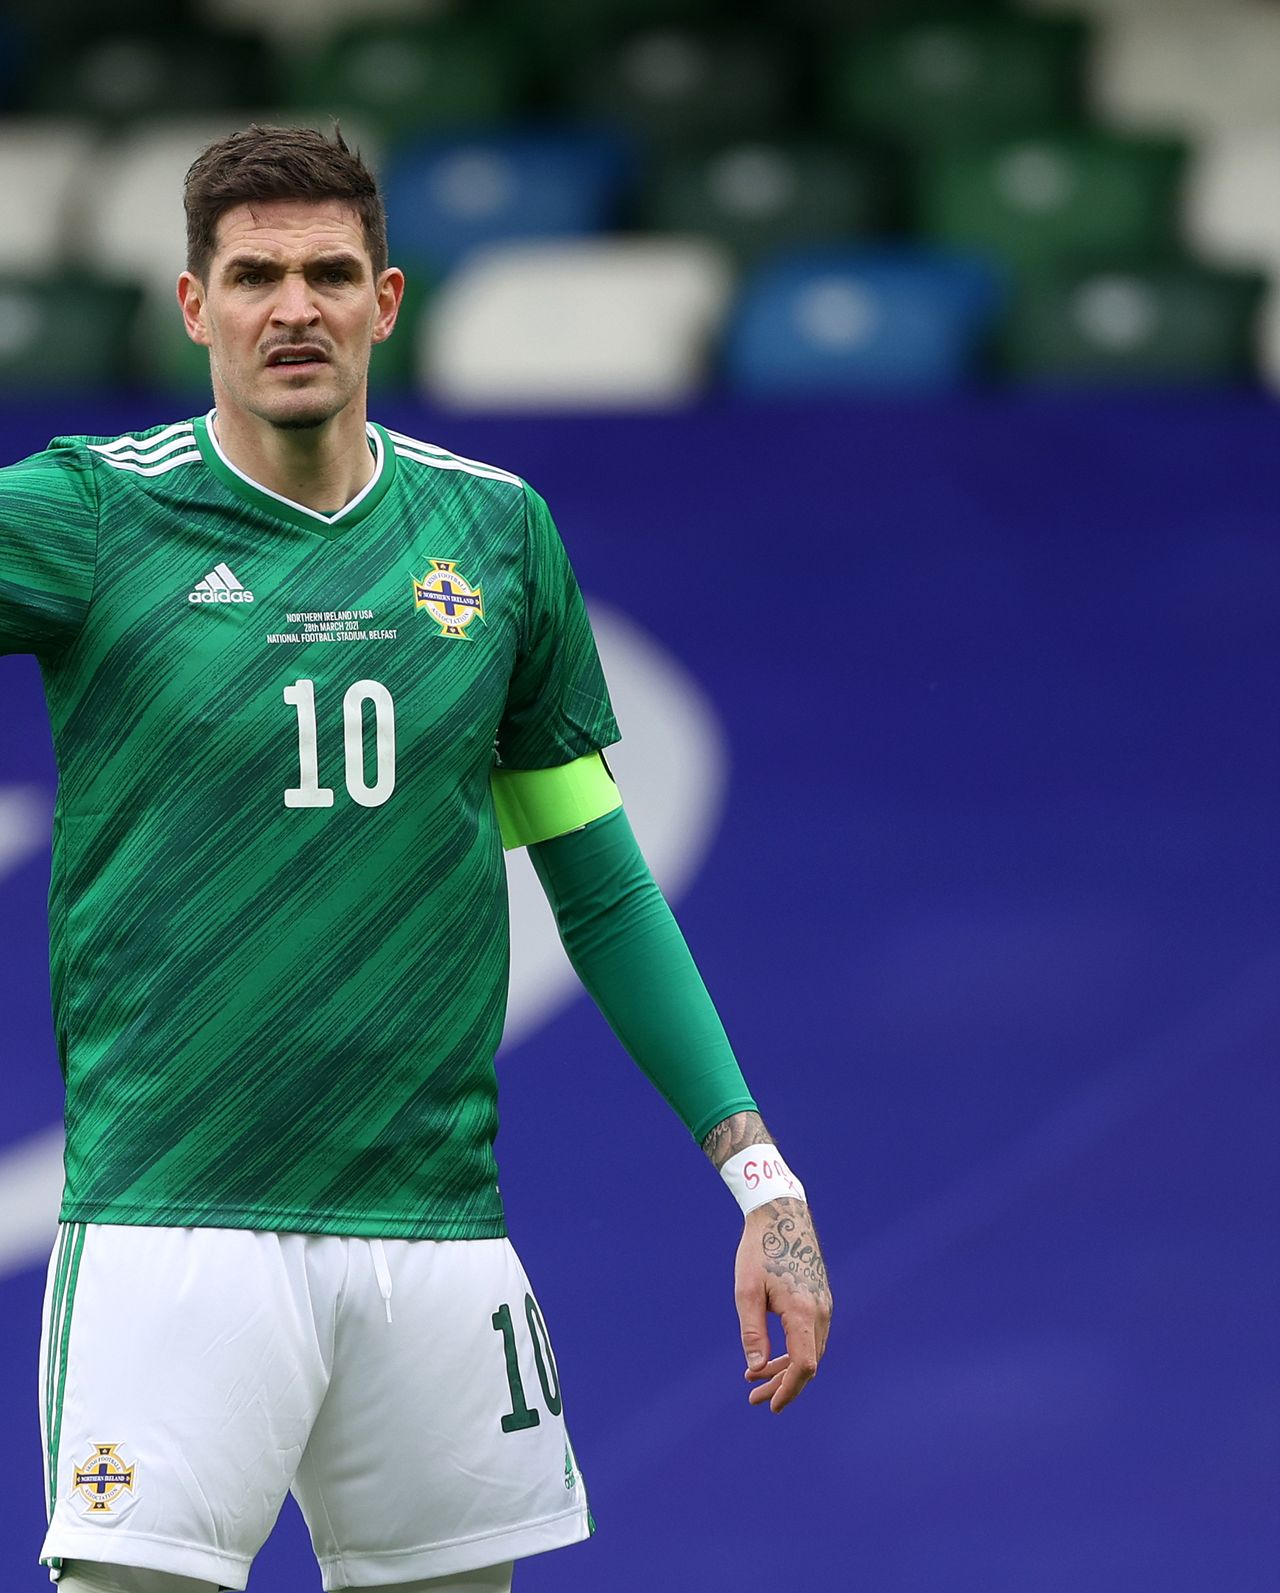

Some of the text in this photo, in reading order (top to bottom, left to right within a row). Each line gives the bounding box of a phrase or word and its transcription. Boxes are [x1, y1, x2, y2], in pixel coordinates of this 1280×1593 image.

[188, 588, 254, 603] adidas
[423, 591, 475, 605] NORTHERN IRELAND
[286, 610, 373, 623] NORTHERN IRELAND V USA
[303, 621, 359, 632] 28th MARCH 2021
[266, 629, 397, 644] NATIONAL FOOTBALL STADIUM, BELFAST
[283, 679, 396, 808] 10
[491, 1293, 562, 1433] 10
